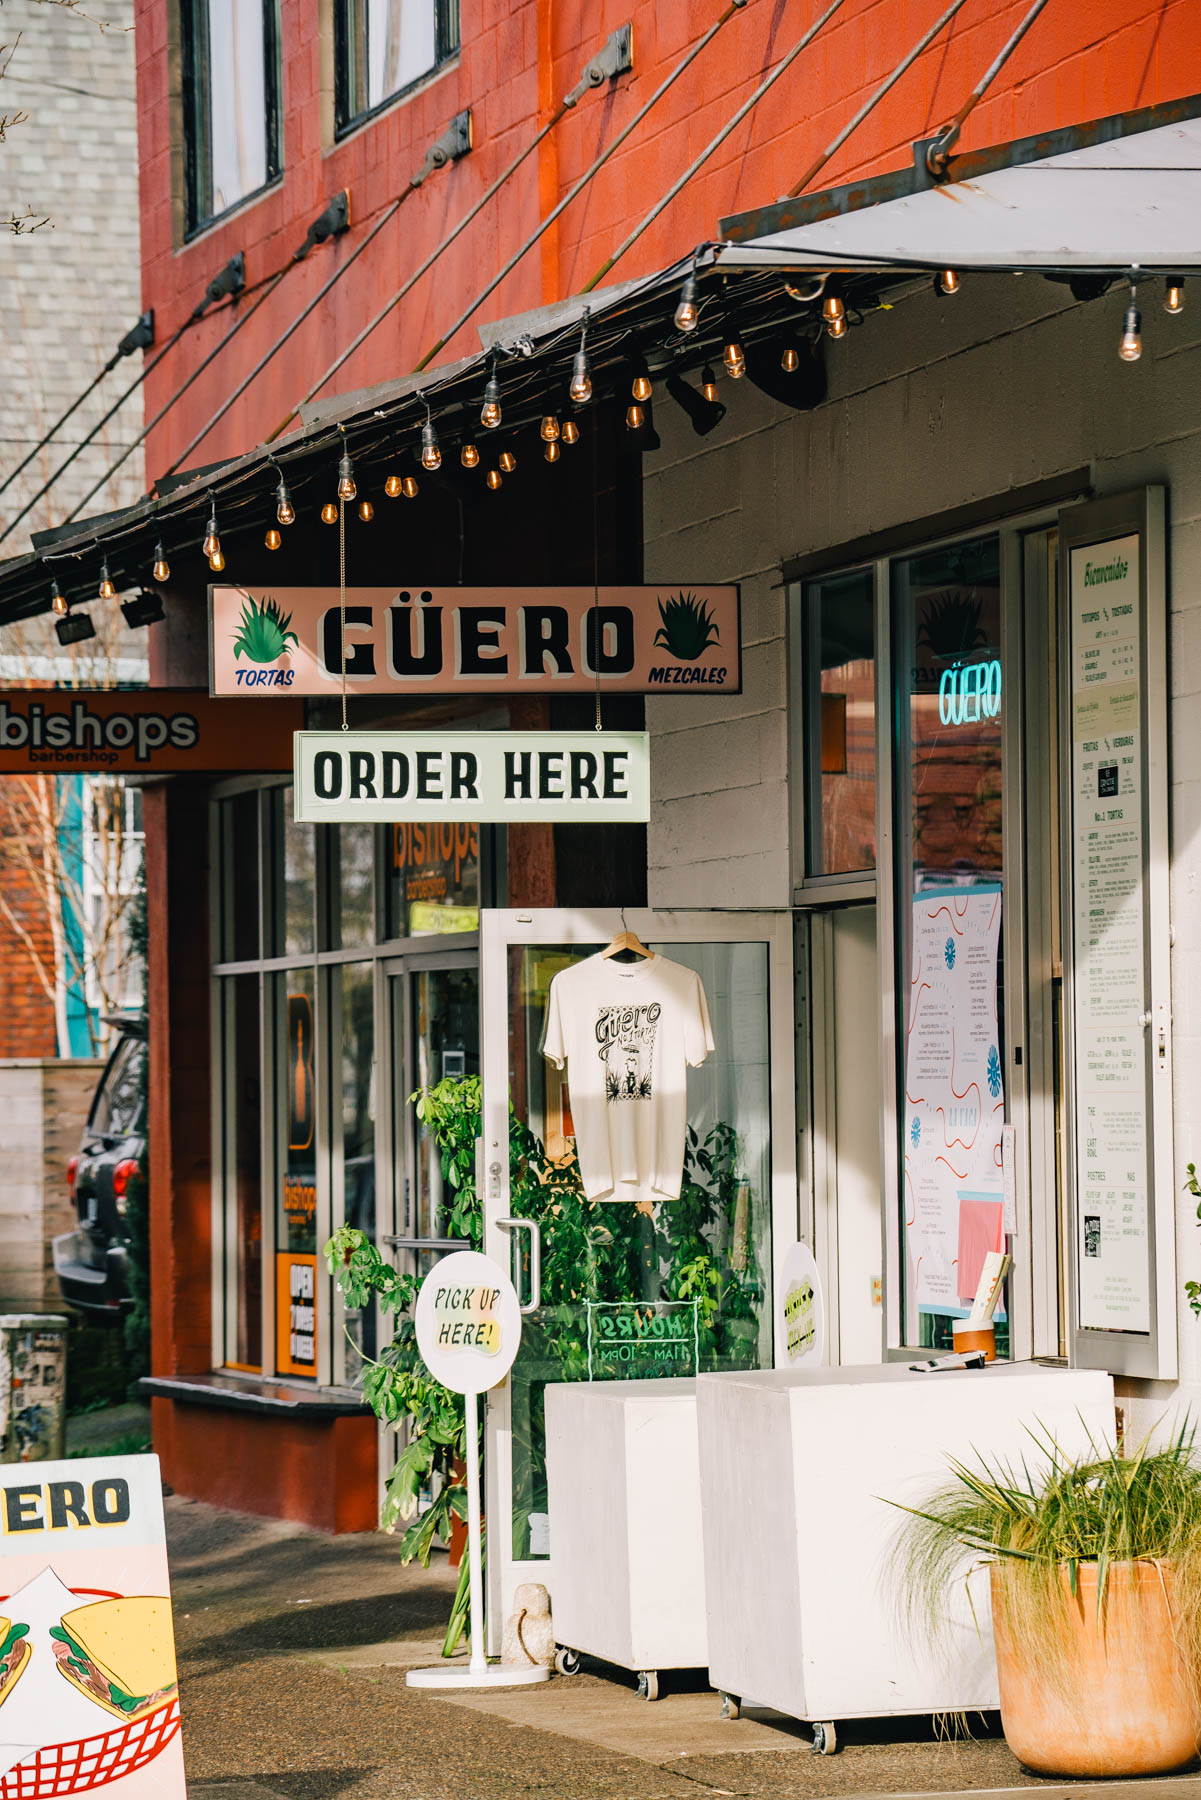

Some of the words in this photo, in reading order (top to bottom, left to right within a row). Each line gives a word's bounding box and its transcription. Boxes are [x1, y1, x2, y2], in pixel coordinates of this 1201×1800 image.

[1084, 556, 1129, 587] Bienvenidos
[318, 590, 636, 680] GÜERO
[235, 668, 295, 687] TORTAS
[648, 665, 728, 686] MEZCALES
[0, 704, 197, 761] bishops
[29, 748, 119, 764] barbershop
[313, 750, 480, 801] ORDER
[504, 750, 631, 801] HERE
[434, 1287, 475, 1310] PICK
[480, 1288, 501, 1310] UP
[439, 1322, 494, 1346] HERE!
